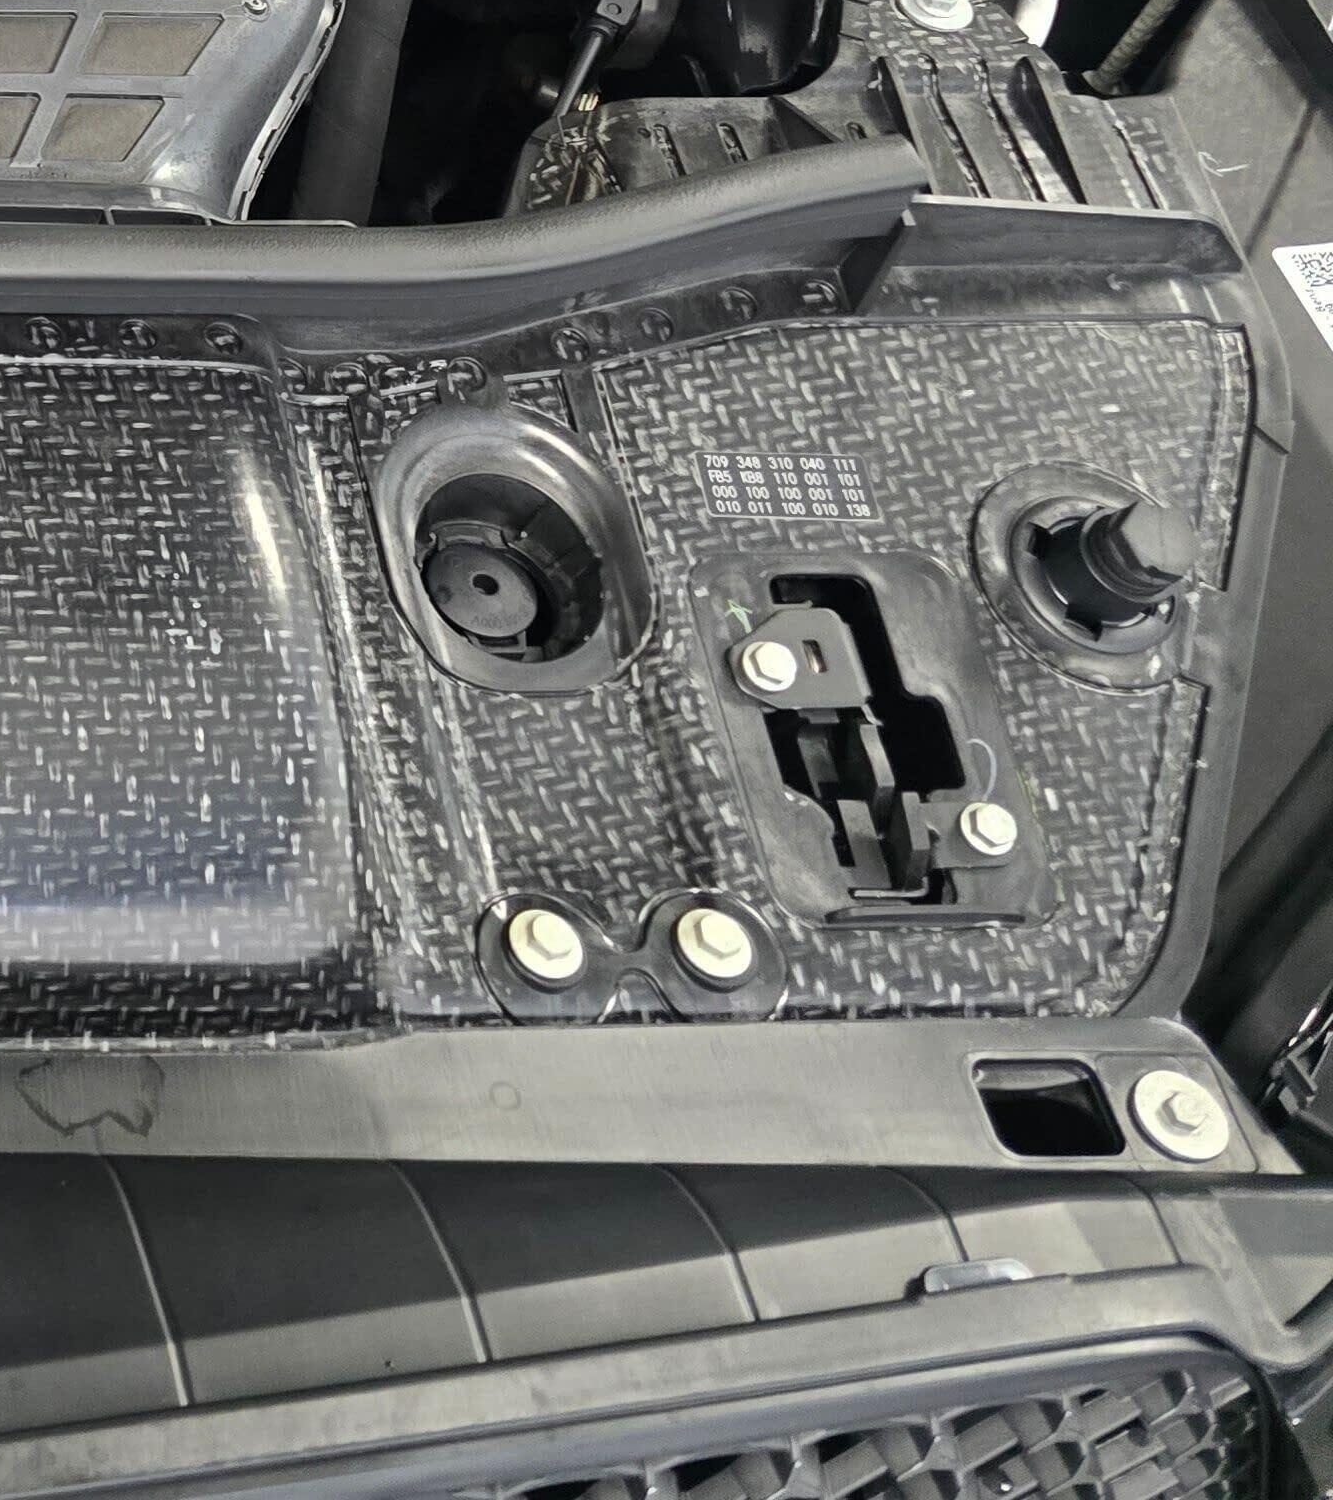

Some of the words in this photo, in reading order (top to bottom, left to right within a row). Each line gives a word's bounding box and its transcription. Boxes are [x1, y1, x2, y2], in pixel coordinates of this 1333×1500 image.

[703, 454, 729, 468] 709
[735, 455, 762, 469] 348
[767, 456, 794, 470] 310
[799, 457, 826, 471] 040
[833, 458, 857, 472] 111
[773, 472, 798, 485] 110
[804, 472, 829, 486] 001
[837, 473, 861, 487] 101
[712, 485, 738, 498] 000
[745, 486, 770, 499] 100
[778, 487, 802, 500] 100
[808, 487, 833, 501] 001
[841, 488, 865, 502] 101
[716, 500, 742, 513] 010
[748, 501, 773, 514] 011
[781, 502, 806, 515] 100
[812, 503, 839, 516] 010
[846, 504, 871, 517] 138
